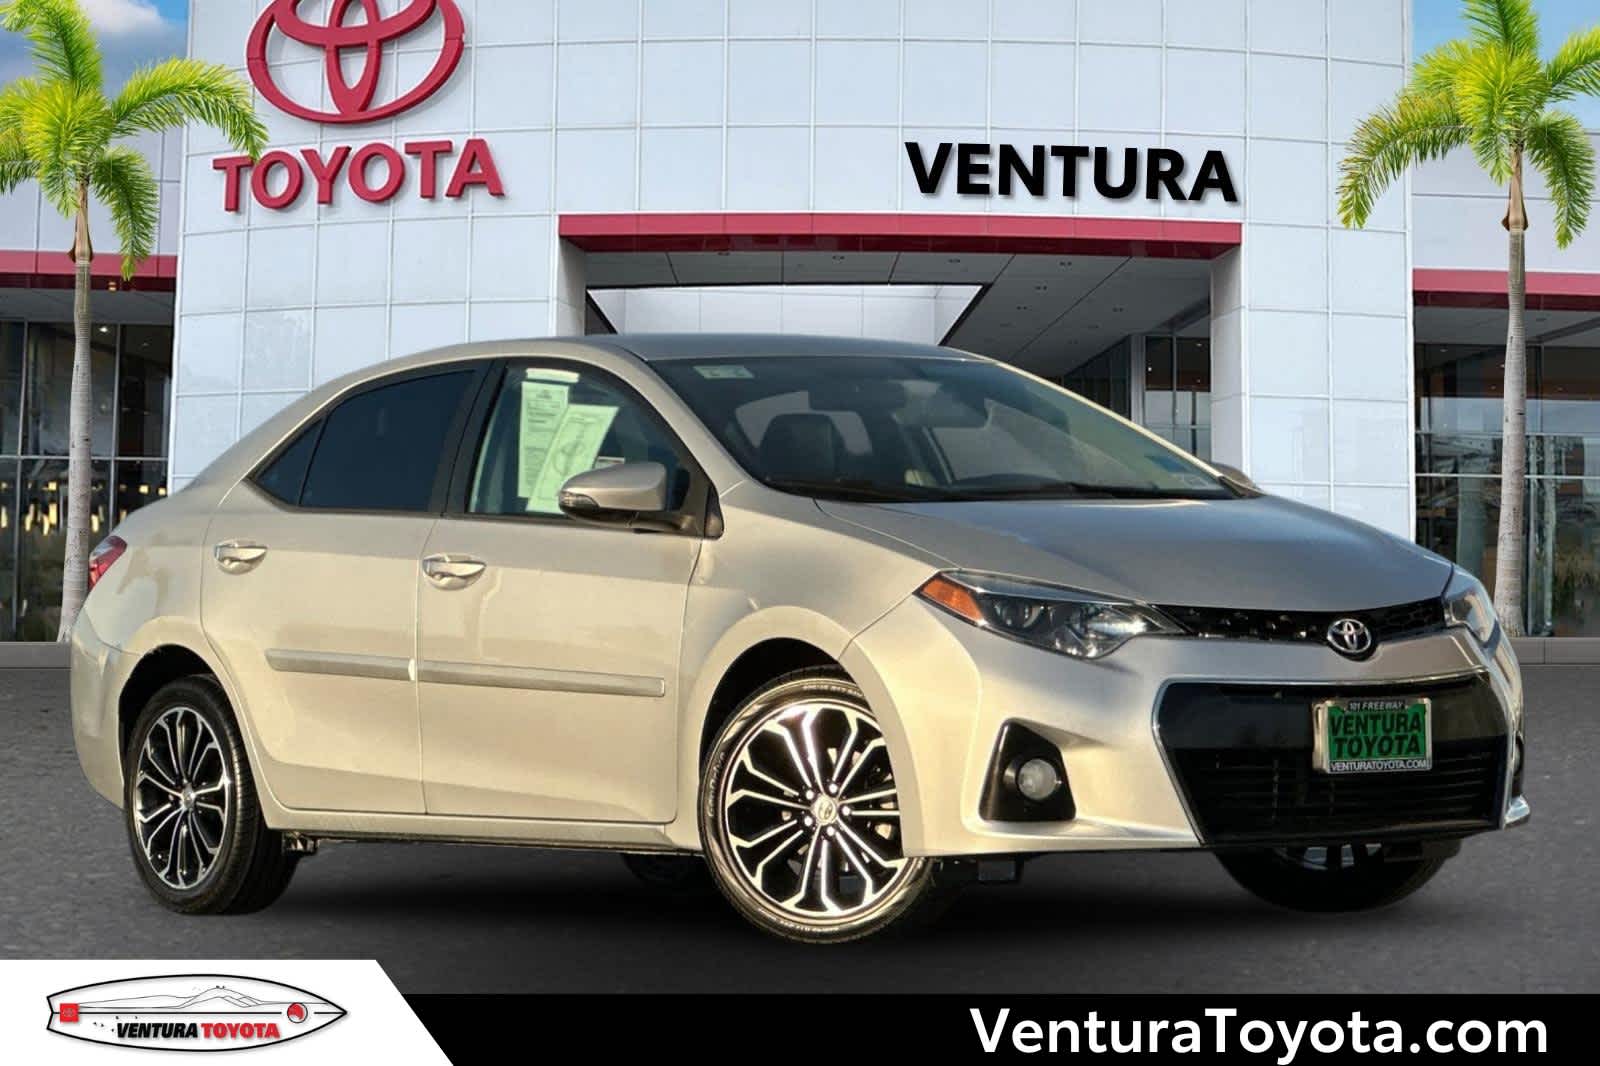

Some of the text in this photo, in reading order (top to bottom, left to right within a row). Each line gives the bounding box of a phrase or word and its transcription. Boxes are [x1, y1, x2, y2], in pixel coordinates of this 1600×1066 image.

[213, 139, 504, 212] TOYOTA
[905, 141, 1238, 203] VENTURA
[1362, 701, 1404, 711] FREEWAY
[1329, 711, 1422, 736] VENTURA
[1334, 734, 1421, 759] TOYOTA
[1331, 759, 1427, 772] VENTURATOYOTA.COM
